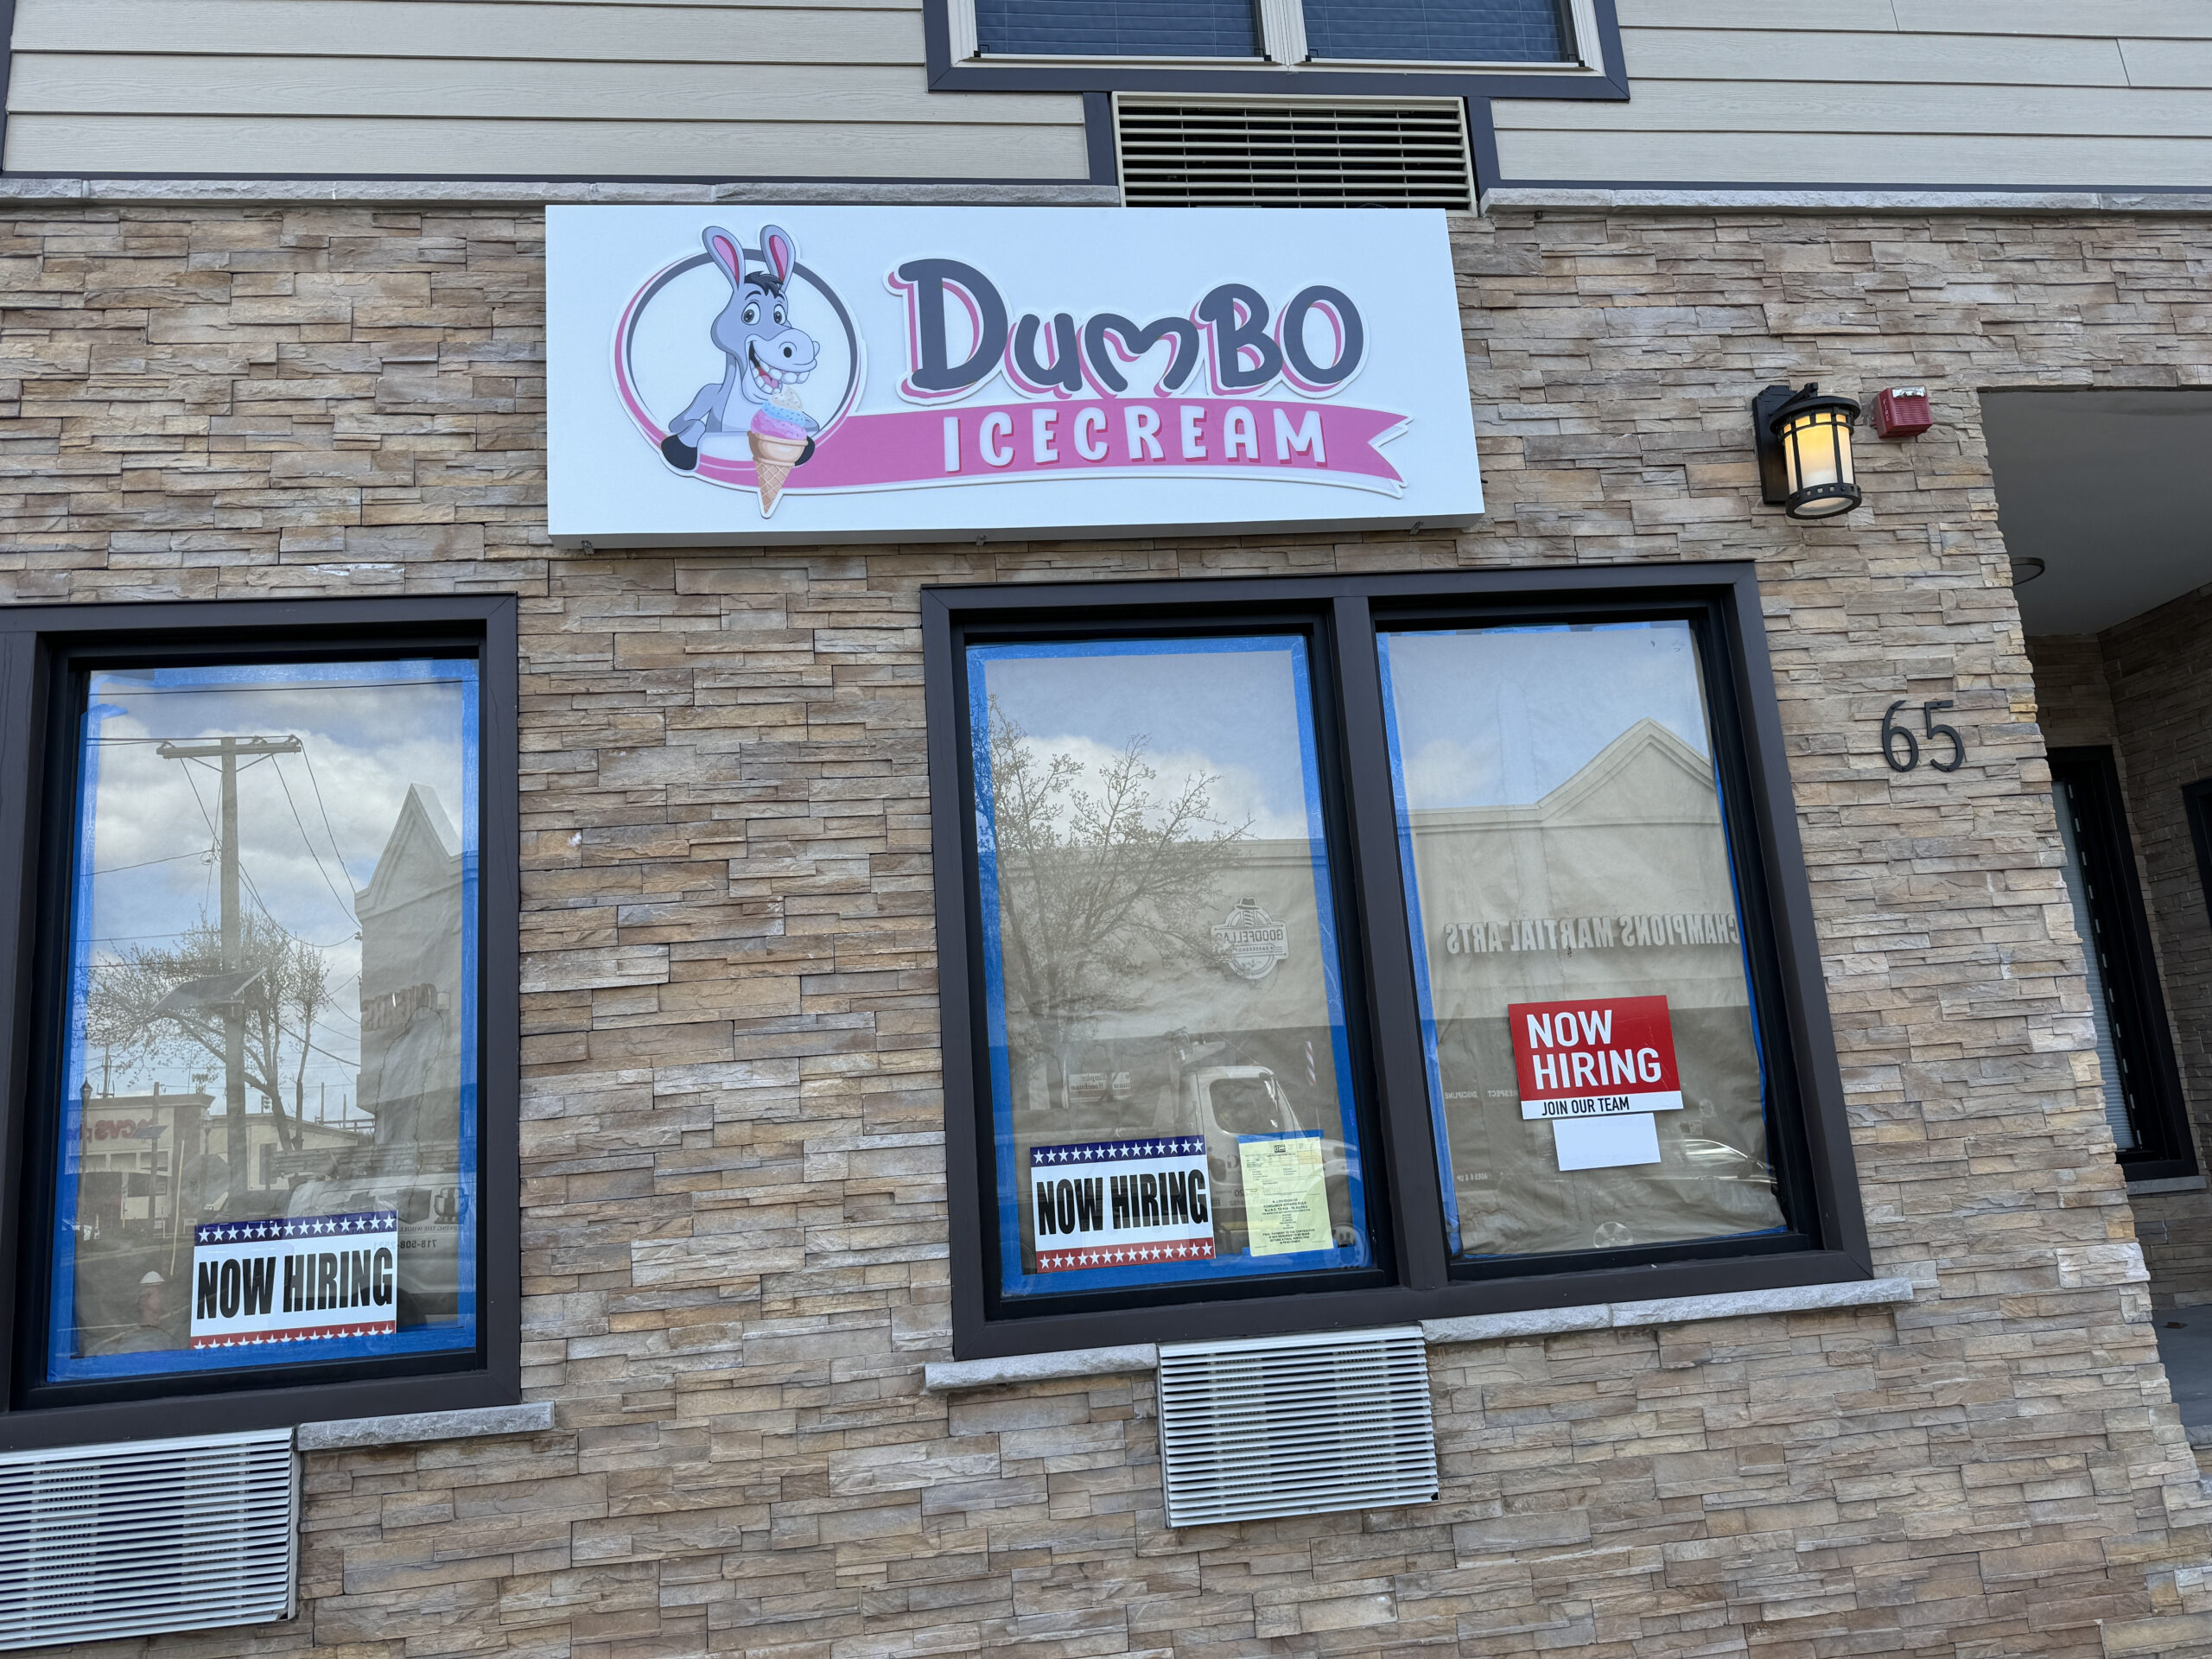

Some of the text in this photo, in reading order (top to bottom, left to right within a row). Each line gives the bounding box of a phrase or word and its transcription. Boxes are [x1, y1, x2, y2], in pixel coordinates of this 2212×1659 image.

[944, 404, 1329, 474] ICECREAM
[1882, 699, 1965, 773] 65
[1527, 1009, 1612, 1048] NOW
[1532, 1047, 1662, 1090] HIRING
[1541, 1095, 1630, 1116] JOIN OUR TEAM
[1036, 1168, 1209, 1236] NOW HIRING
[196, 1247, 393, 1320] NOW HIRING
